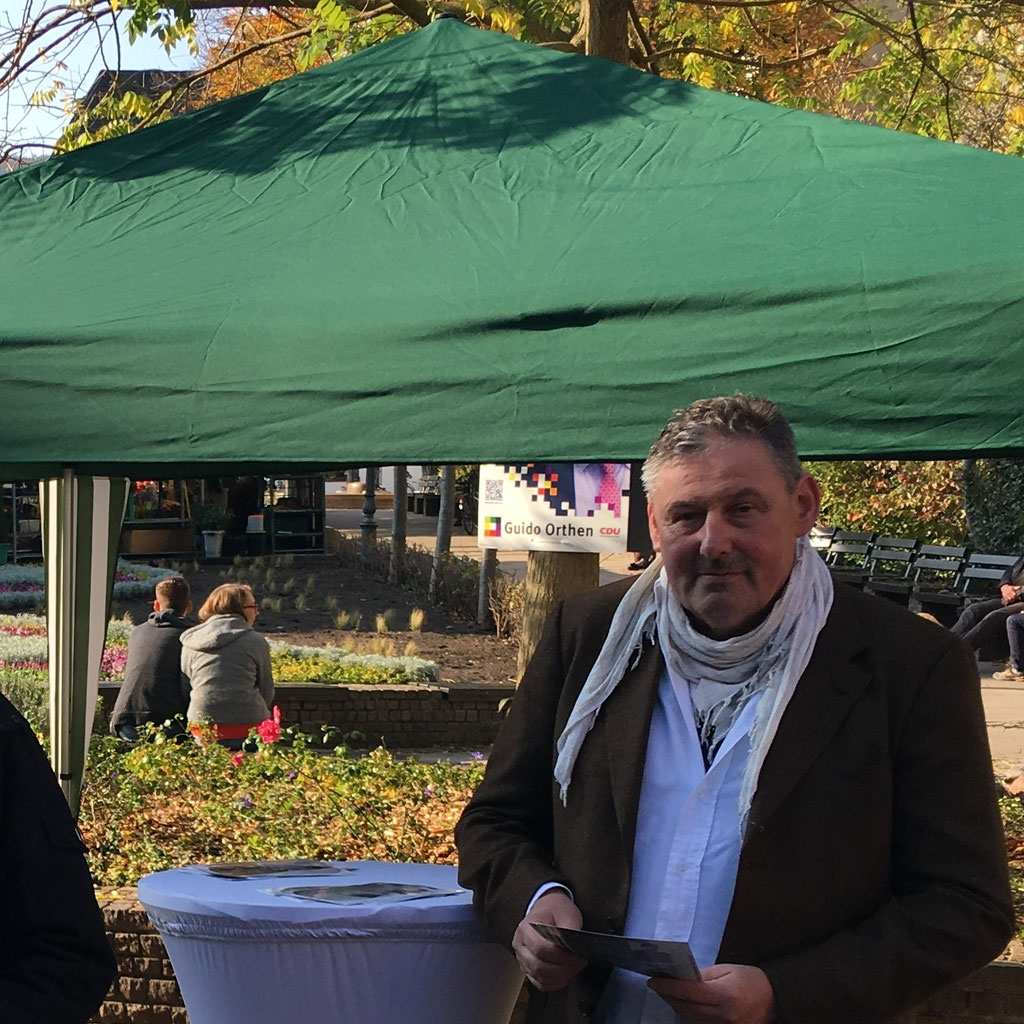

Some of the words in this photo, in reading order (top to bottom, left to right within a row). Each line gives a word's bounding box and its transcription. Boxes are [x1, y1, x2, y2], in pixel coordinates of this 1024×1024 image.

[504, 521, 541, 536] Guido
[545, 523, 594, 537] Orthen
[599, 527, 621, 535] CDU
